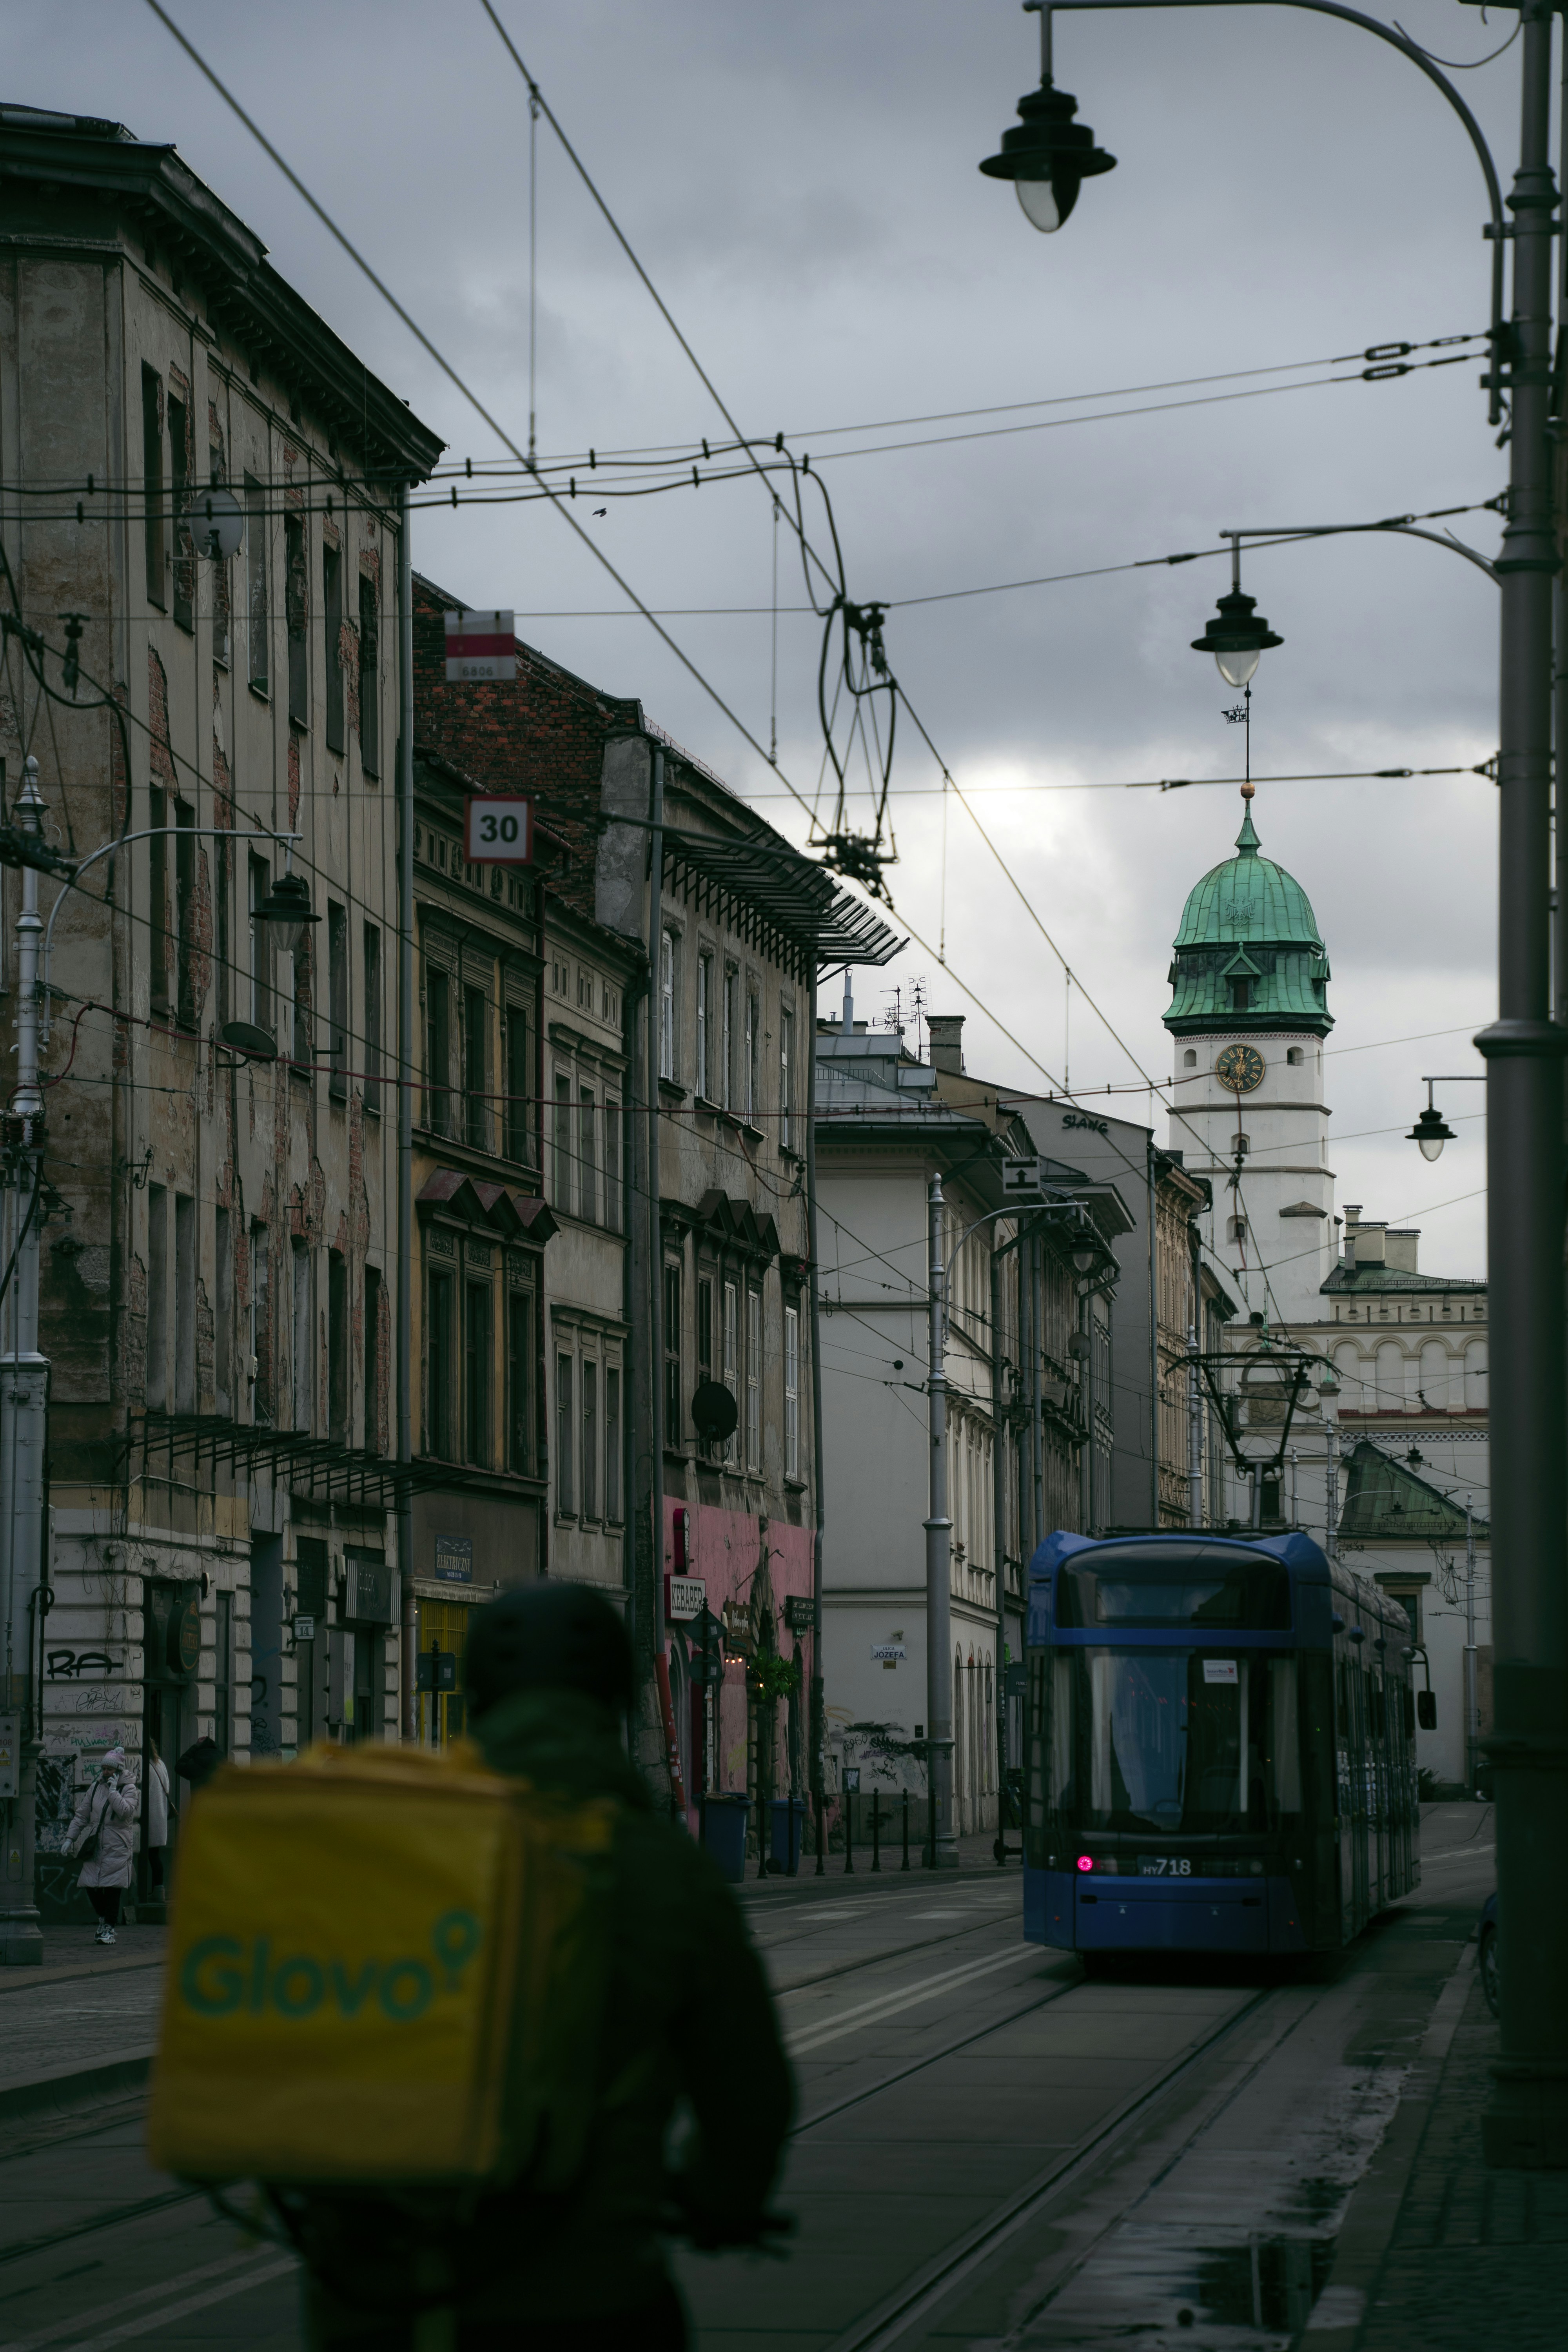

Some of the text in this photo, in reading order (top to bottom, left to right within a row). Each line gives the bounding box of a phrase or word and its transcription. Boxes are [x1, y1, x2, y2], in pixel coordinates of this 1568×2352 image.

[463, 666, 493, 677] 6806
[480, 814, 518, 842] 30
[1062, 1114, 1109, 1133] SLANG
[437, 1555, 471, 1572] ELEKTRYCZNY
[671, 1583, 703, 1613] KEBABER
[300, 1627, 309, 1636] 14
[182, 1933, 434, 2020] Glovo
